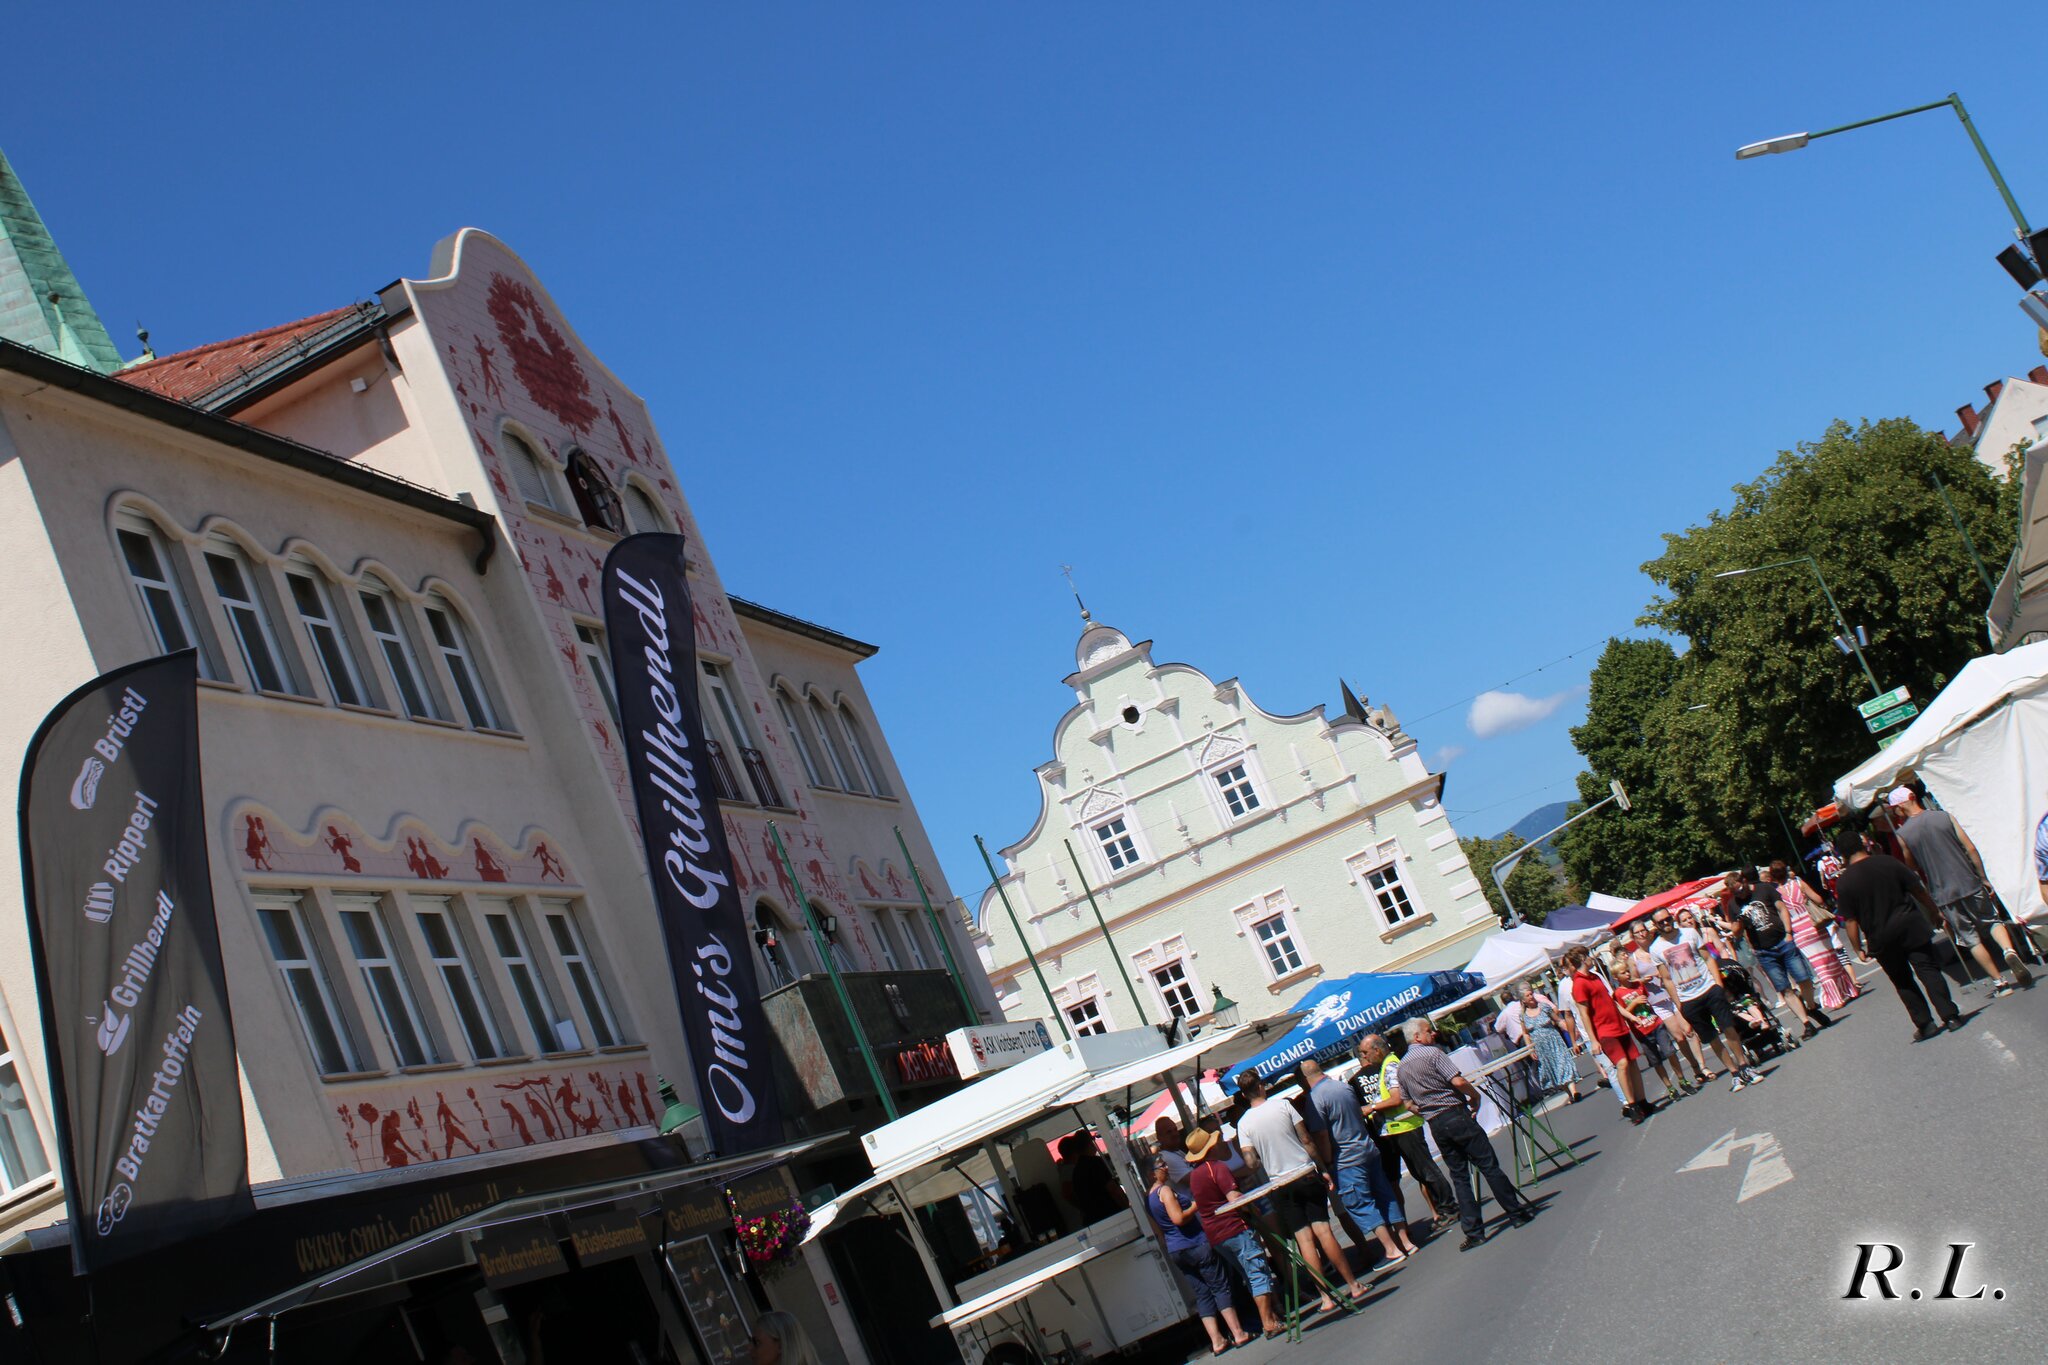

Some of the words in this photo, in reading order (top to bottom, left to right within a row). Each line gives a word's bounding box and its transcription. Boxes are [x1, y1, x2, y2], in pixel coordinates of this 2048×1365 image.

[94, 686, 148, 764] Brüstl
[615, 567, 728, 910] Grillhendl
[103, 791, 159, 884] Ripperl
[110, 890, 175, 1009] Grillhendl
[691, 932, 756, 1124] Omi's
[1336, 985, 1422, 1036] PUNTIGAMER
[116, 1004, 203, 1182] Bratkartoffeln
[480, 1237, 561, 1277] Bratkartoffeln
[668, 1196, 726, 1231] Grillhendl
